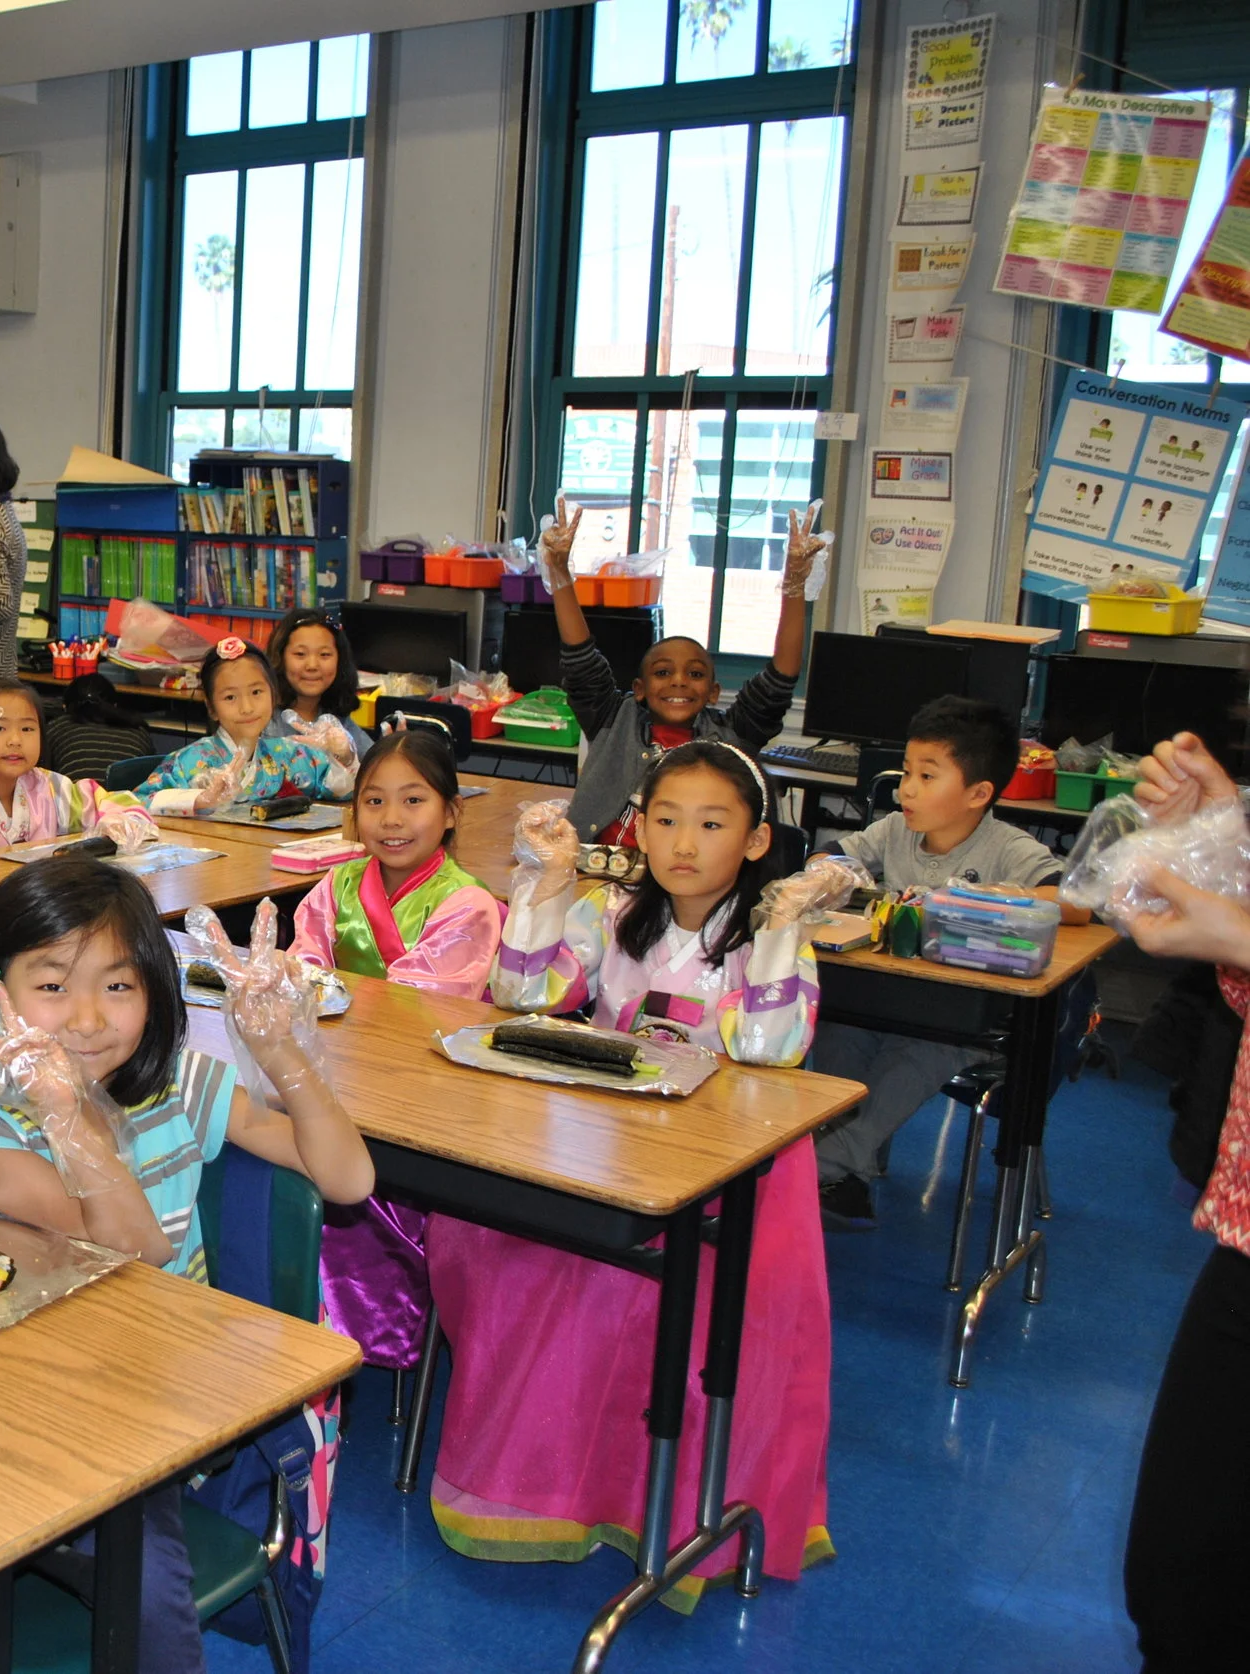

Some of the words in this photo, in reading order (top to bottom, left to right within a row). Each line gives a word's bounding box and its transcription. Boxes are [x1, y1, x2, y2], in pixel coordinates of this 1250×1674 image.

[920, 40, 951, 53] Good
[940, 104, 967, 114] Draw
[1082, 95, 1118, 109] More
[1121, 99, 1196, 115] Descriptive
[938, 117, 975, 128] Picture
[924, 246, 946, 258] Look
[928, 260, 960, 271] Pattern
[927, 316, 948, 325] Make
[1075, 380, 1177, 411] Conversation
[1180, 401, 1231, 424] Norms
[1079, 441, 1093, 450] Use
[1094, 446, 1112, 455] your
[911, 457, 936, 467] Make
[1074, 449, 1093, 460] think
[1094, 452, 1111, 463] time
[1144, 456, 1158, 466] Use
[1159, 458, 1173, 469] the
[1174, 462, 1211, 477] language
[912, 470, 940, 482] Graph
[1157, 468, 1165, 477] of
[1166, 470, 1179, 479] the
[1180, 473, 1195, 482] skill
[1059, 507, 1073, 516] Use
[1074, 510, 1091, 520] your
[1038, 511, 1085, 528] conversation
[1086, 522, 1107, 533] voice
[900, 526, 916, 536] Act
[917, 528, 925, 536] It
[1142, 527, 1164, 538] Listen
[895, 539, 911, 548] Use
[914, 539, 943, 551] Objects
[1130, 534, 1172, 550] respectfully
[1028, 558, 1038, 566] on
[1039, 561, 1057, 572] each
[1058, 566, 1081, 578] other's
[1033, 550, 1050, 561] Take
[1051, 556, 1068, 565] turns
[1069, 560, 1083, 569] and
[1084, 563, 1103, 574] build
